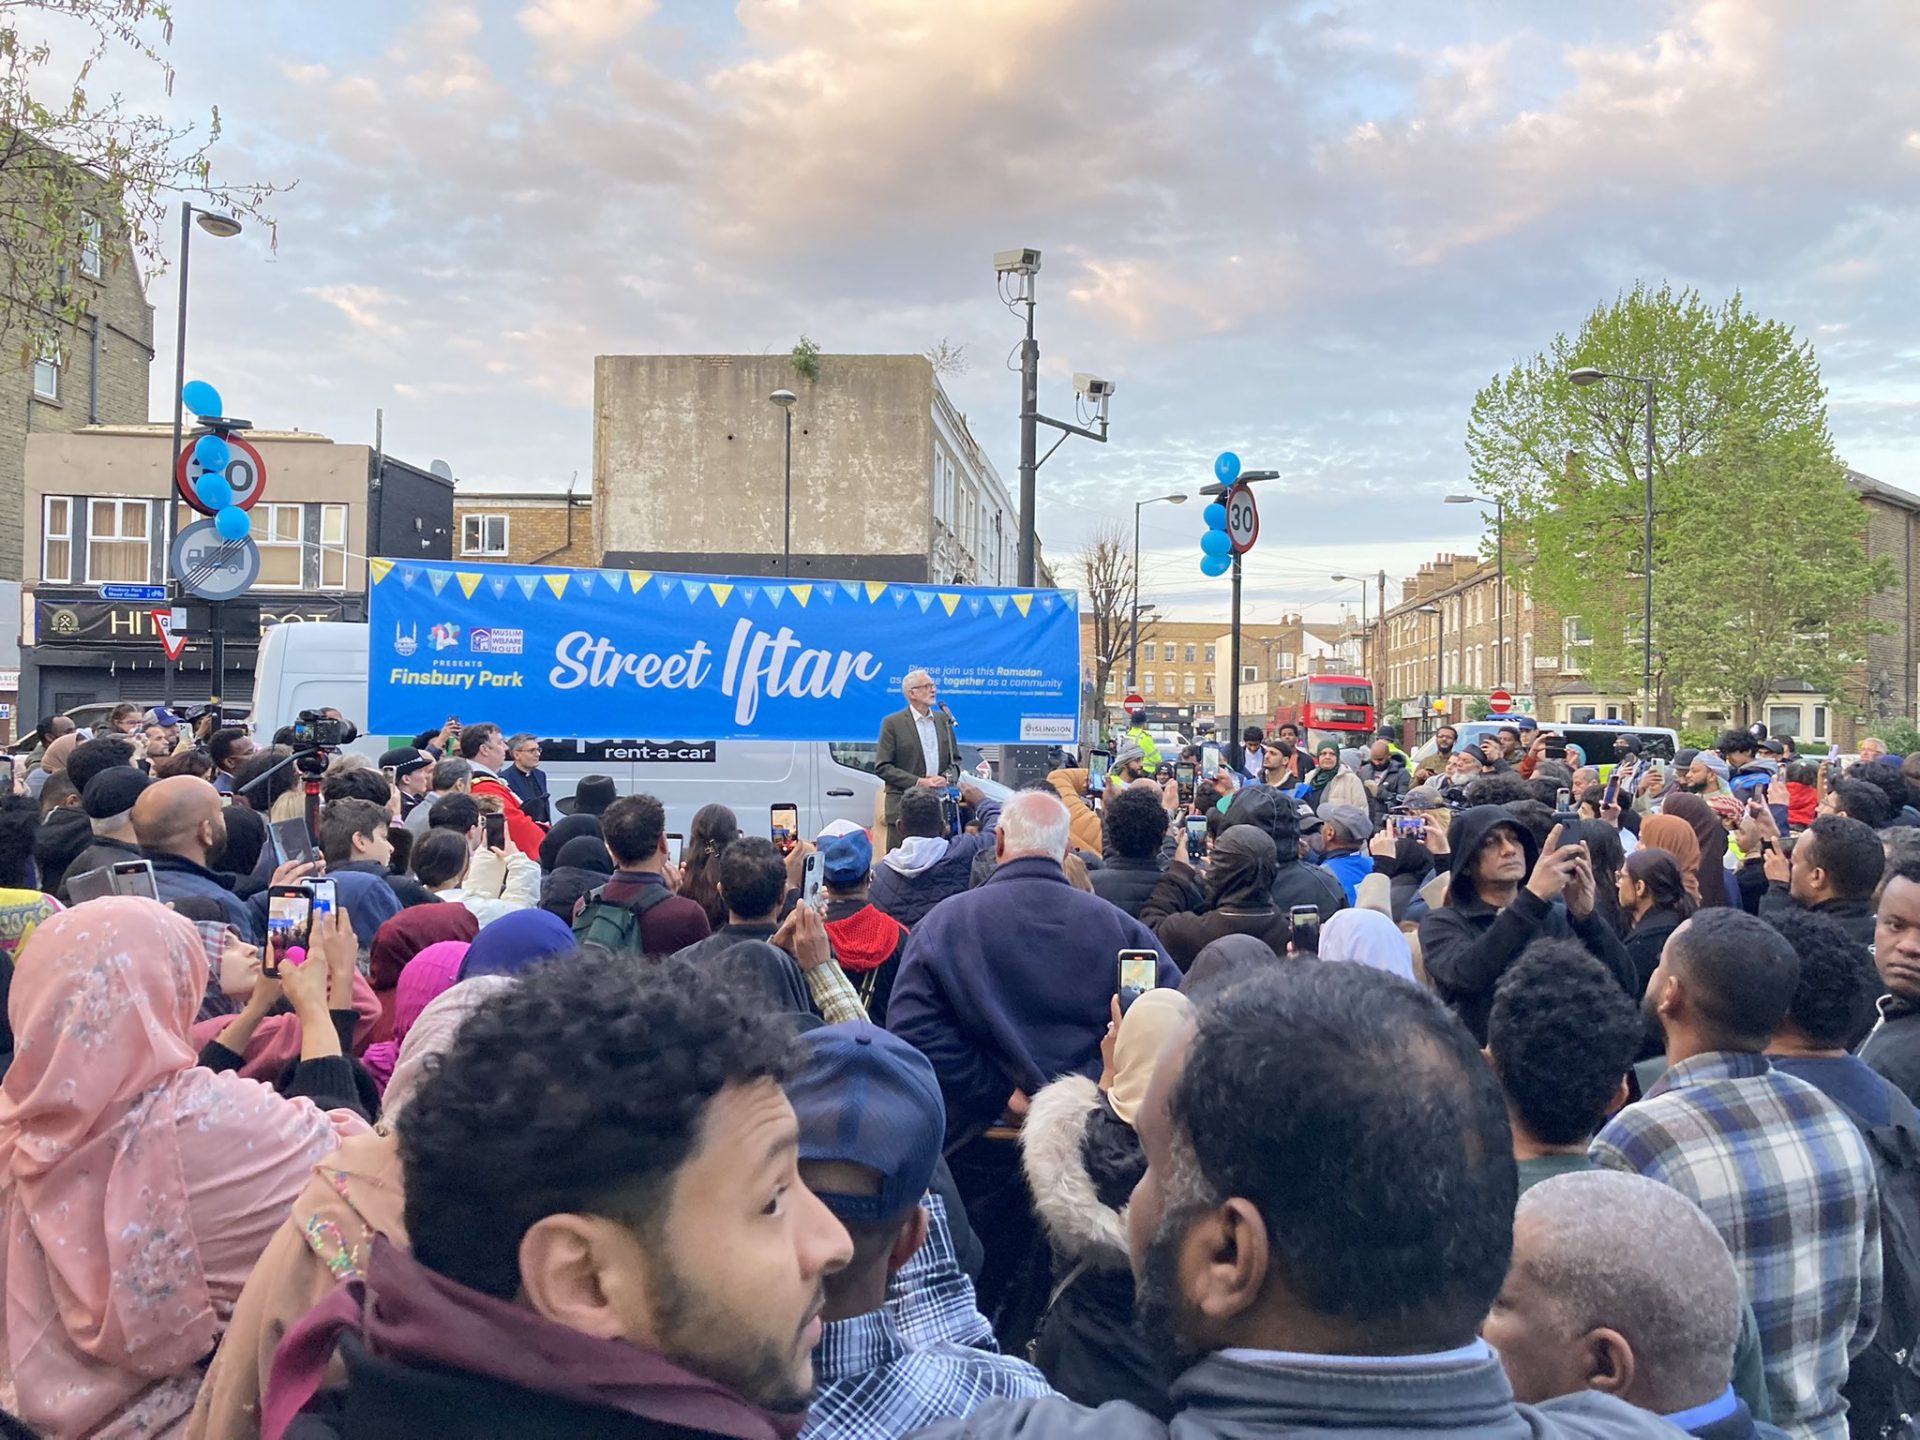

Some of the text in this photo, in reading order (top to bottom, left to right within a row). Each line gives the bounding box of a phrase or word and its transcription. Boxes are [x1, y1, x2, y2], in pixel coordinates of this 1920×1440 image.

[1231, 504, 1253, 533] 30
[492, 629, 522, 637] MUSLIM
[492, 637, 521, 645] WELFARE
[491, 645, 521, 653] HOUSE
[433, 659, 483, 668] PRESENTS
[549, 617, 882, 726] Street Iftar
[942, 665, 960, 677] join
[977, 666, 995, 676] this
[996, 666, 1043, 677] Ramadan
[390, 668, 523, 690] Finsbury Park
[889, 676, 902, 684] as
[944, 676, 985, 688] together
[1001, 679, 1007, 687] a
[1009, 678, 1063, 690] community
[1032, 725, 1071, 733] ISLINGTON
[605, 746, 711, 759] rent-a-car
